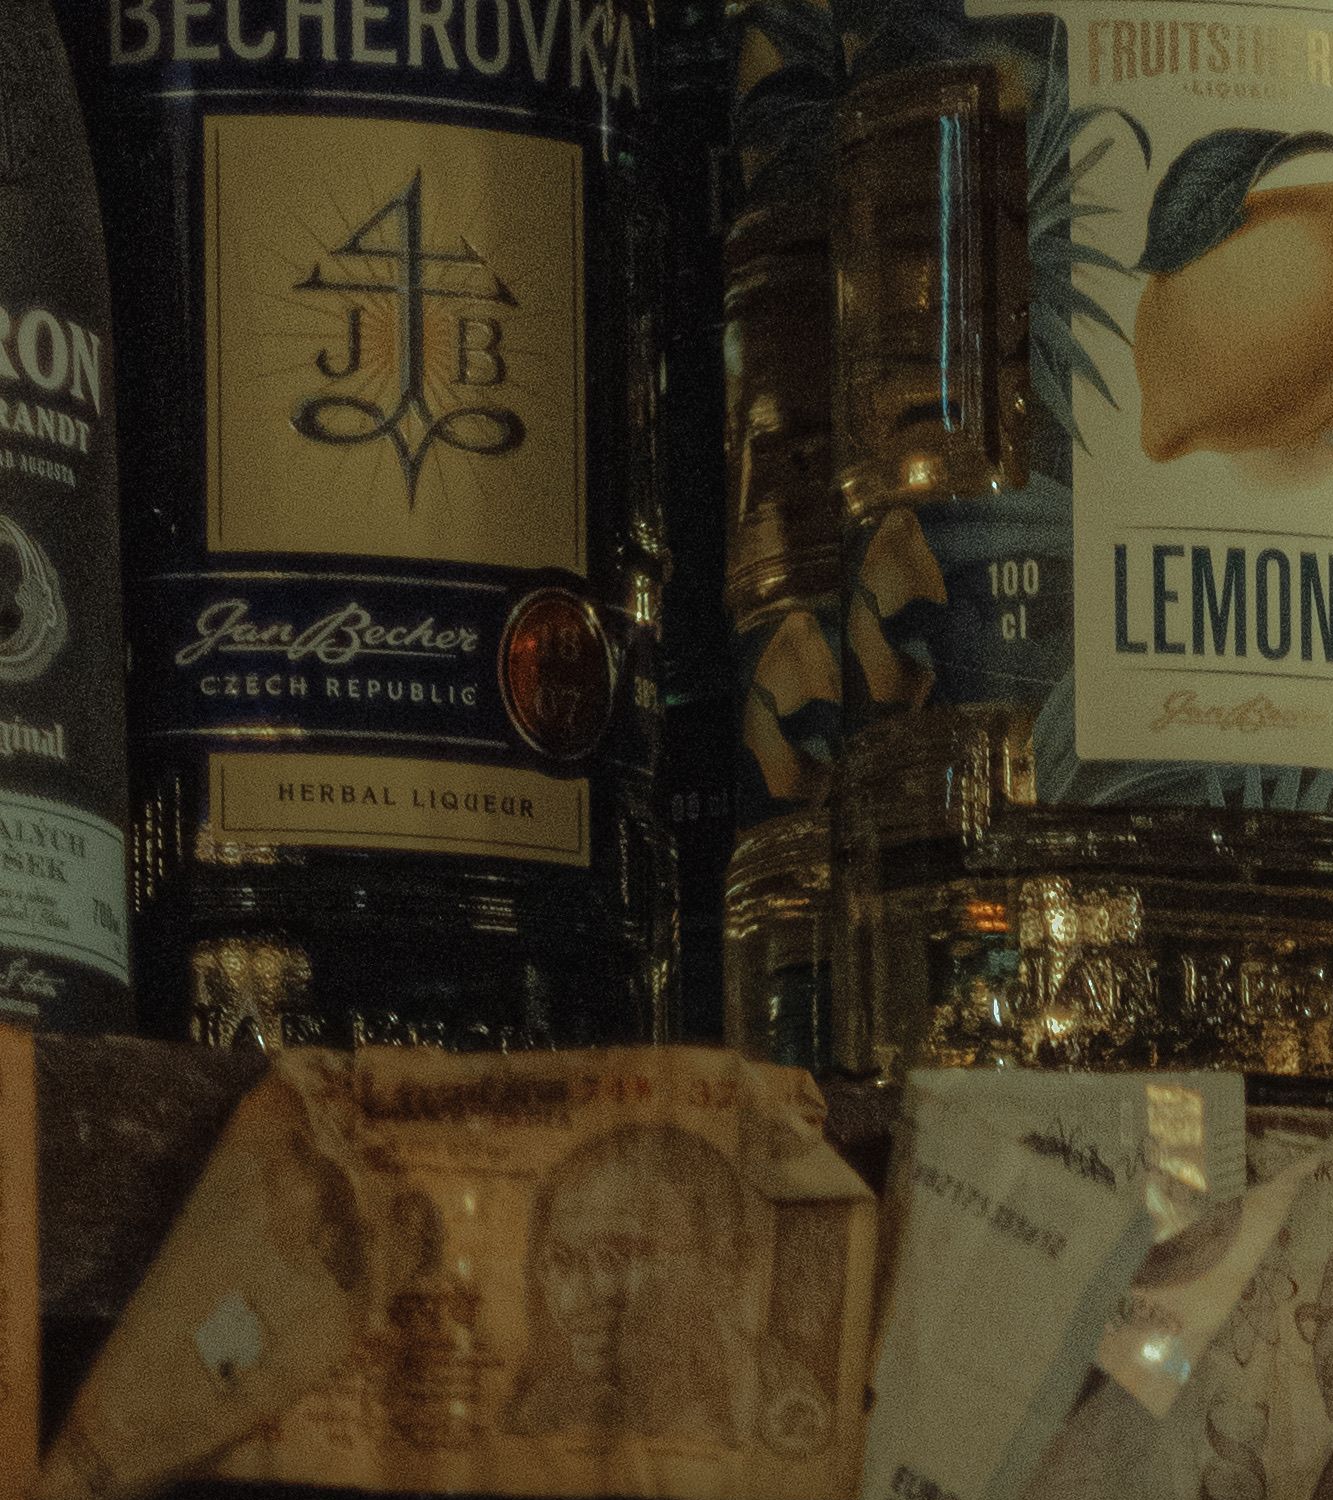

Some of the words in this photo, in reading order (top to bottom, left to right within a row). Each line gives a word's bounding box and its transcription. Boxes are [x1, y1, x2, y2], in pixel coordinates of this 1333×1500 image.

[108, 0, 641, 108] BECHEROVKA
[455, 317, 507, 387] B
[988, 560, 1040, 596] 100
[174, 598, 296, 667] Jan
[286, 602, 480, 664] Becher
[1001, 602, 1028, 640] cl
[199, 673, 307, 698] CZECH
[325, 676, 478, 706] REPUBLIC
[278, 782, 401, 808] HERBAL
[412, 788, 535, 819] LIQUEUR
